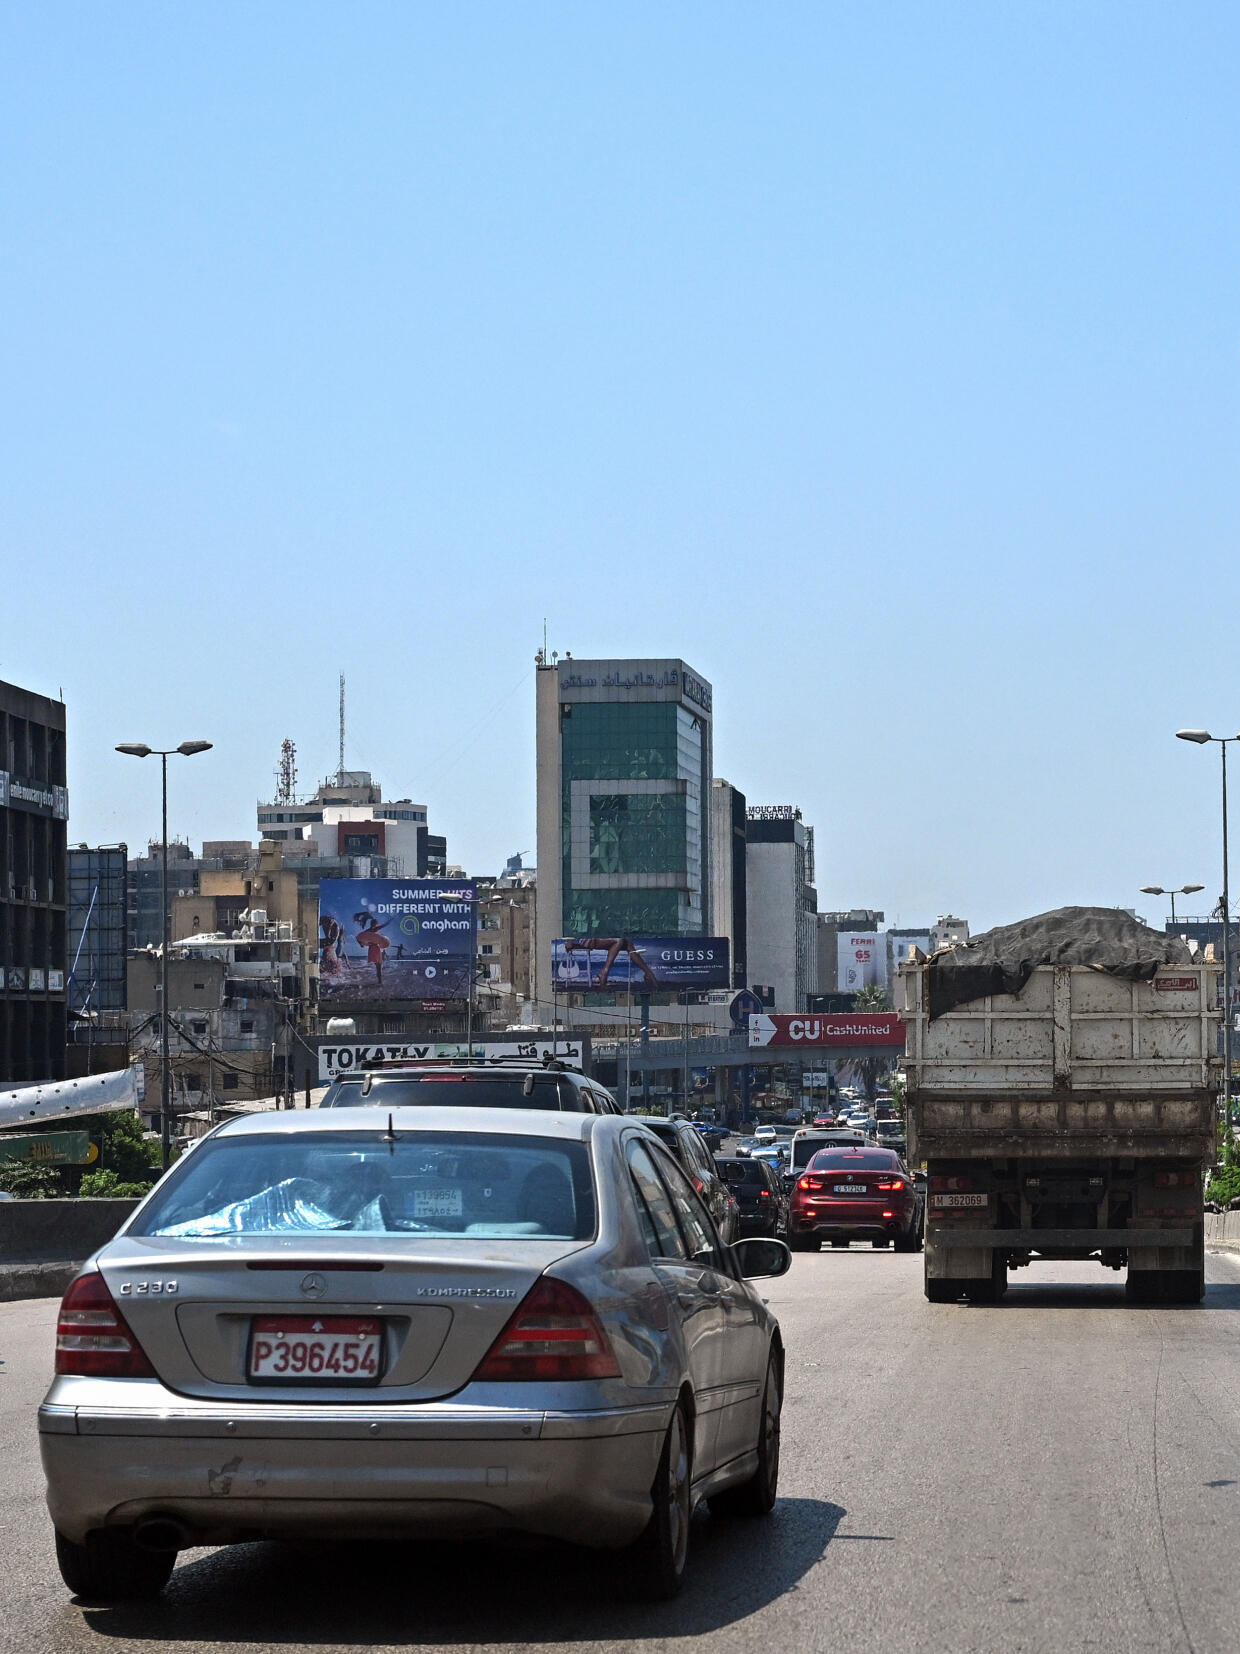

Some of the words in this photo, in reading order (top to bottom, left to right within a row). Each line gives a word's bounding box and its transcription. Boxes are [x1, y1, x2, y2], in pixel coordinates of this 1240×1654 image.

[377, 903, 441, 914] DIFFERENT
[442, 903, 471, 914] WITH
[421, 918, 471, 933] angham
[661, 950, 714, 961] GUESS
[855, 949, 871, 959] 65
[789, 1020, 820, 1040] CU
[826, 1024, 890, 1035] CashUnited
[949, 1195, 982, 1205] 362069
[120, 1282, 131, 1296] C
[136, 1280, 180, 1295] 230
[417, 1287, 517, 1299] KOMPRESSOR
[253, 1341, 376, 1374] P396454
